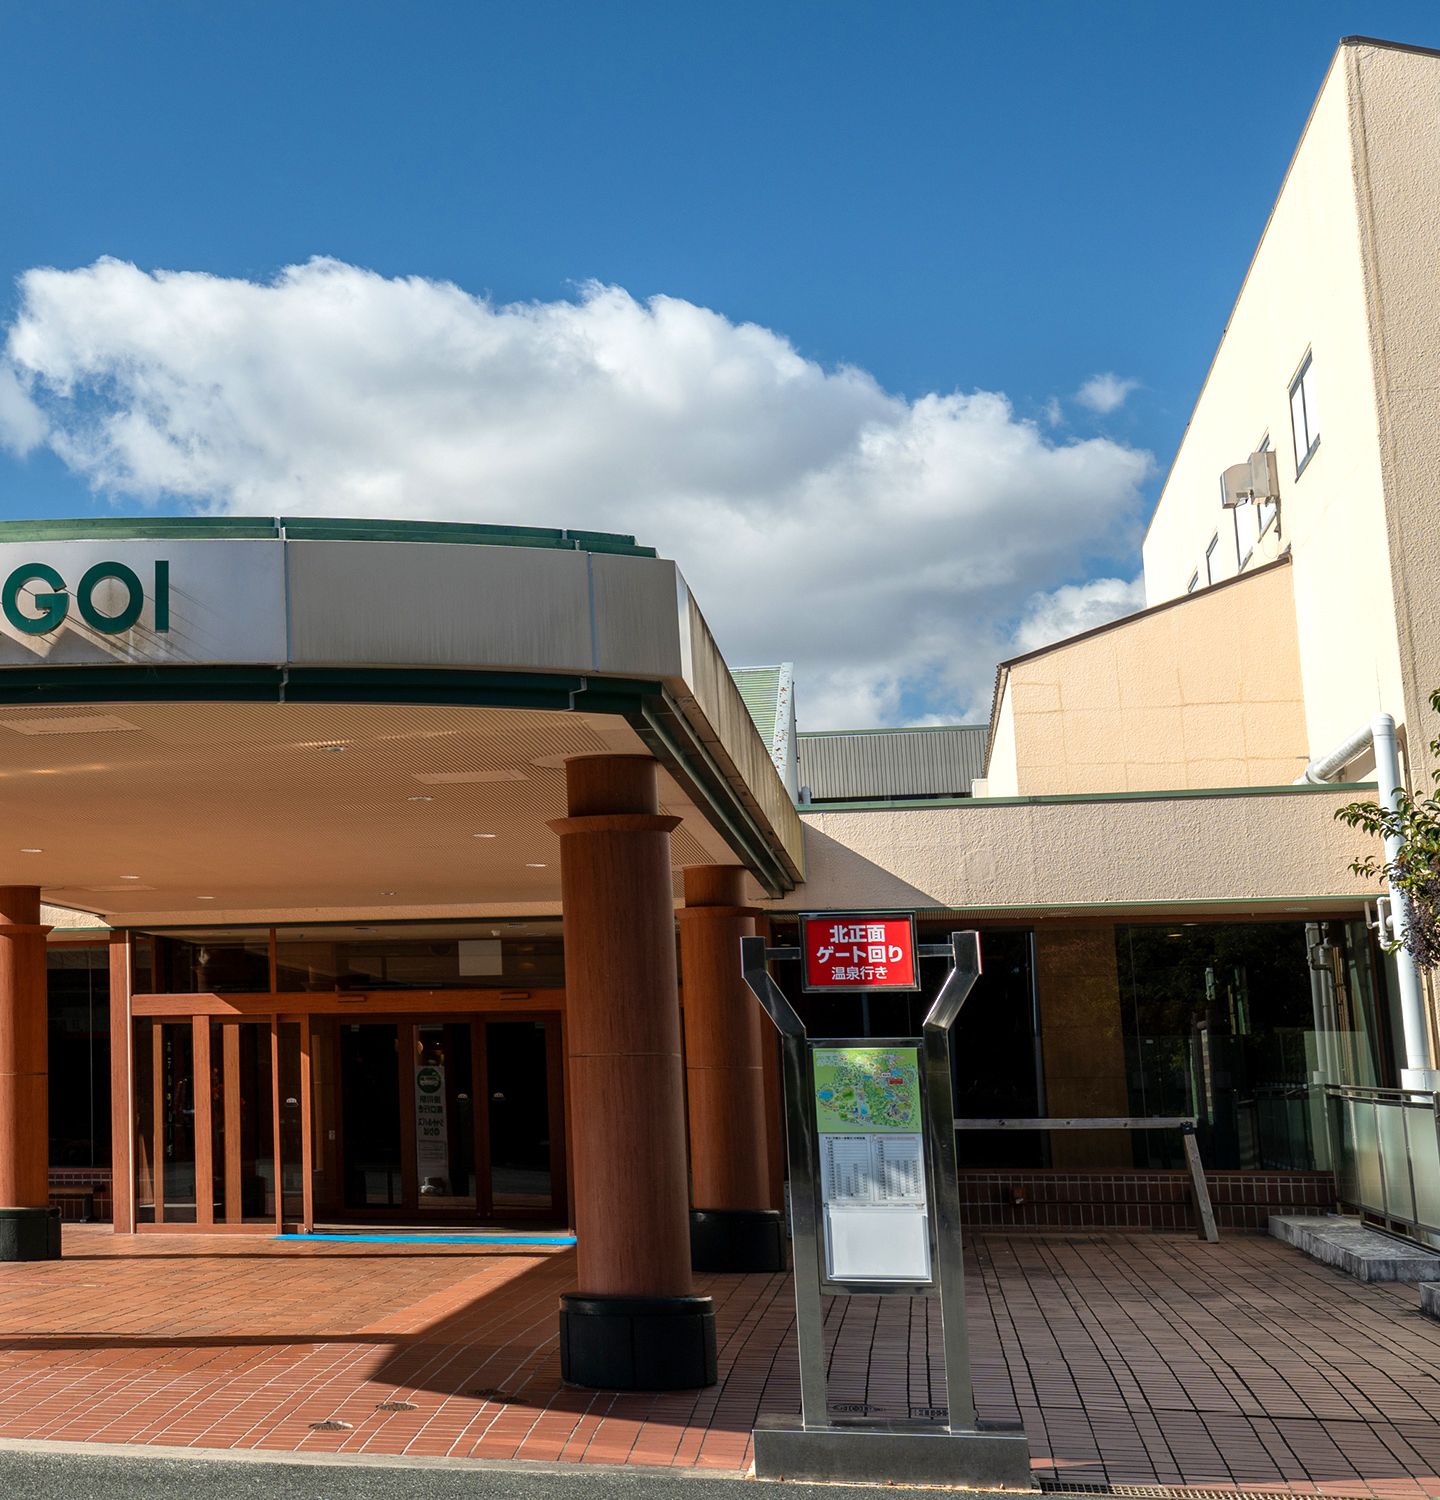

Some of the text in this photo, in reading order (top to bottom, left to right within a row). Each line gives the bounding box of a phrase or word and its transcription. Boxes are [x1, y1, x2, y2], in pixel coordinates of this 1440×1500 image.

[829, 924, 886, 944] 北正面
[816, 945, 903, 965] ゲート回り
[831, 966, 888, 981] 温泉行き
